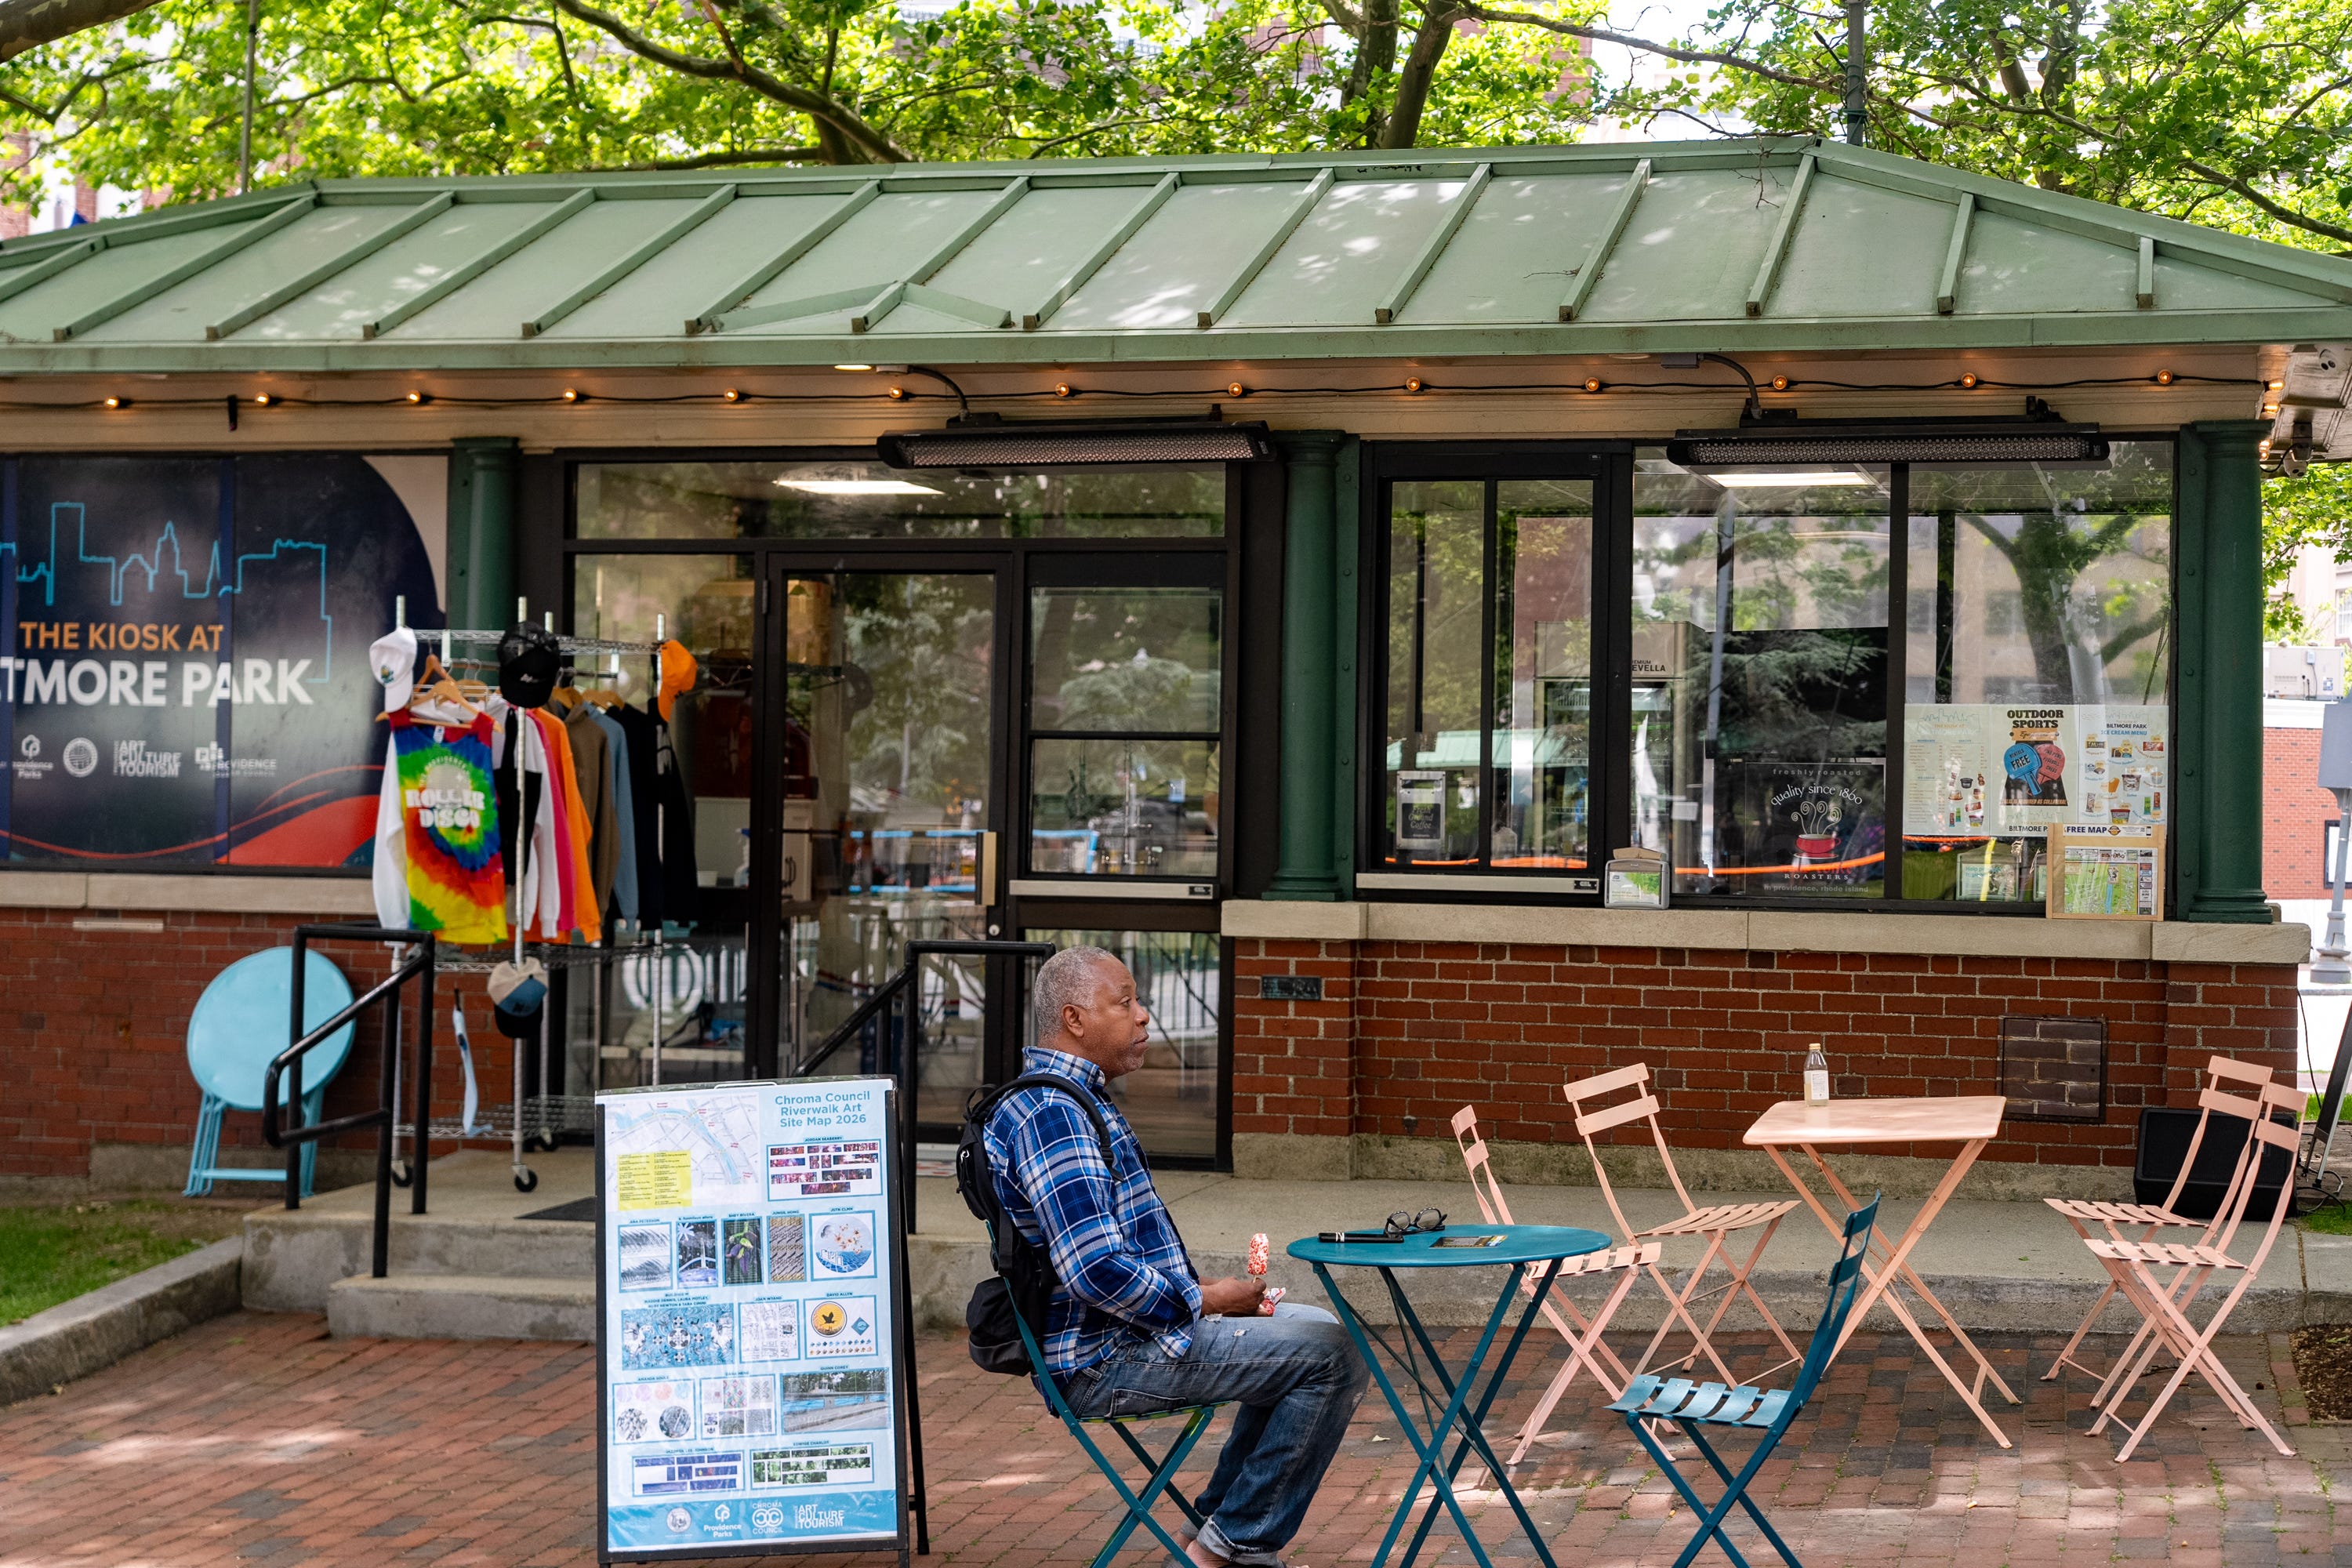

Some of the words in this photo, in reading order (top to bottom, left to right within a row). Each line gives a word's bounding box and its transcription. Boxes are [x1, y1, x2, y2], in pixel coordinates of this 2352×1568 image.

[20, 622, 79, 650] THE
[89, 622, 180, 652] KIOSK
[187, 624, 223, 652] AT
[181, 659, 314, 707] PARK
[2007, 710, 2064, 719] OUTDOOR
[2012, 720, 2058, 728] SPORTS
[119, 740, 146, 751] ART
[119, 750, 182, 764] CULTURE
[2011, 754, 2031, 770] FREE
[12, 760, 54, 770] rovidence
[119, 761, 181, 778] TOURISM
[18, 769, 42, 778] Parks
[1773, 768, 1814, 777] freshly
[405, 789, 485, 810] ROLLER
[1771, 784, 1805, 806] quality
[1808, 783, 1836, 795] since
[1838, 788, 1863, 805] 1860
[418, 808, 481, 828] DISCO
[1410, 821, 1432, 830] Coffee
[1773, 884, 1818, 892] providence,
[775, 1094, 822, 1105] Chroma
[826, 1091, 870, 1102] Council
[780, 1104, 839, 1116] Riverwalk
[843, 1103, 862, 1112] Art
[780, 1118, 803, 1127] Site
[807, 1117, 832, 1127] Map
[836, 1114, 866, 1124] 2026
[798, 1510, 845, 1521] CULTURE
[798, 1519, 844, 1528] TOURISM
